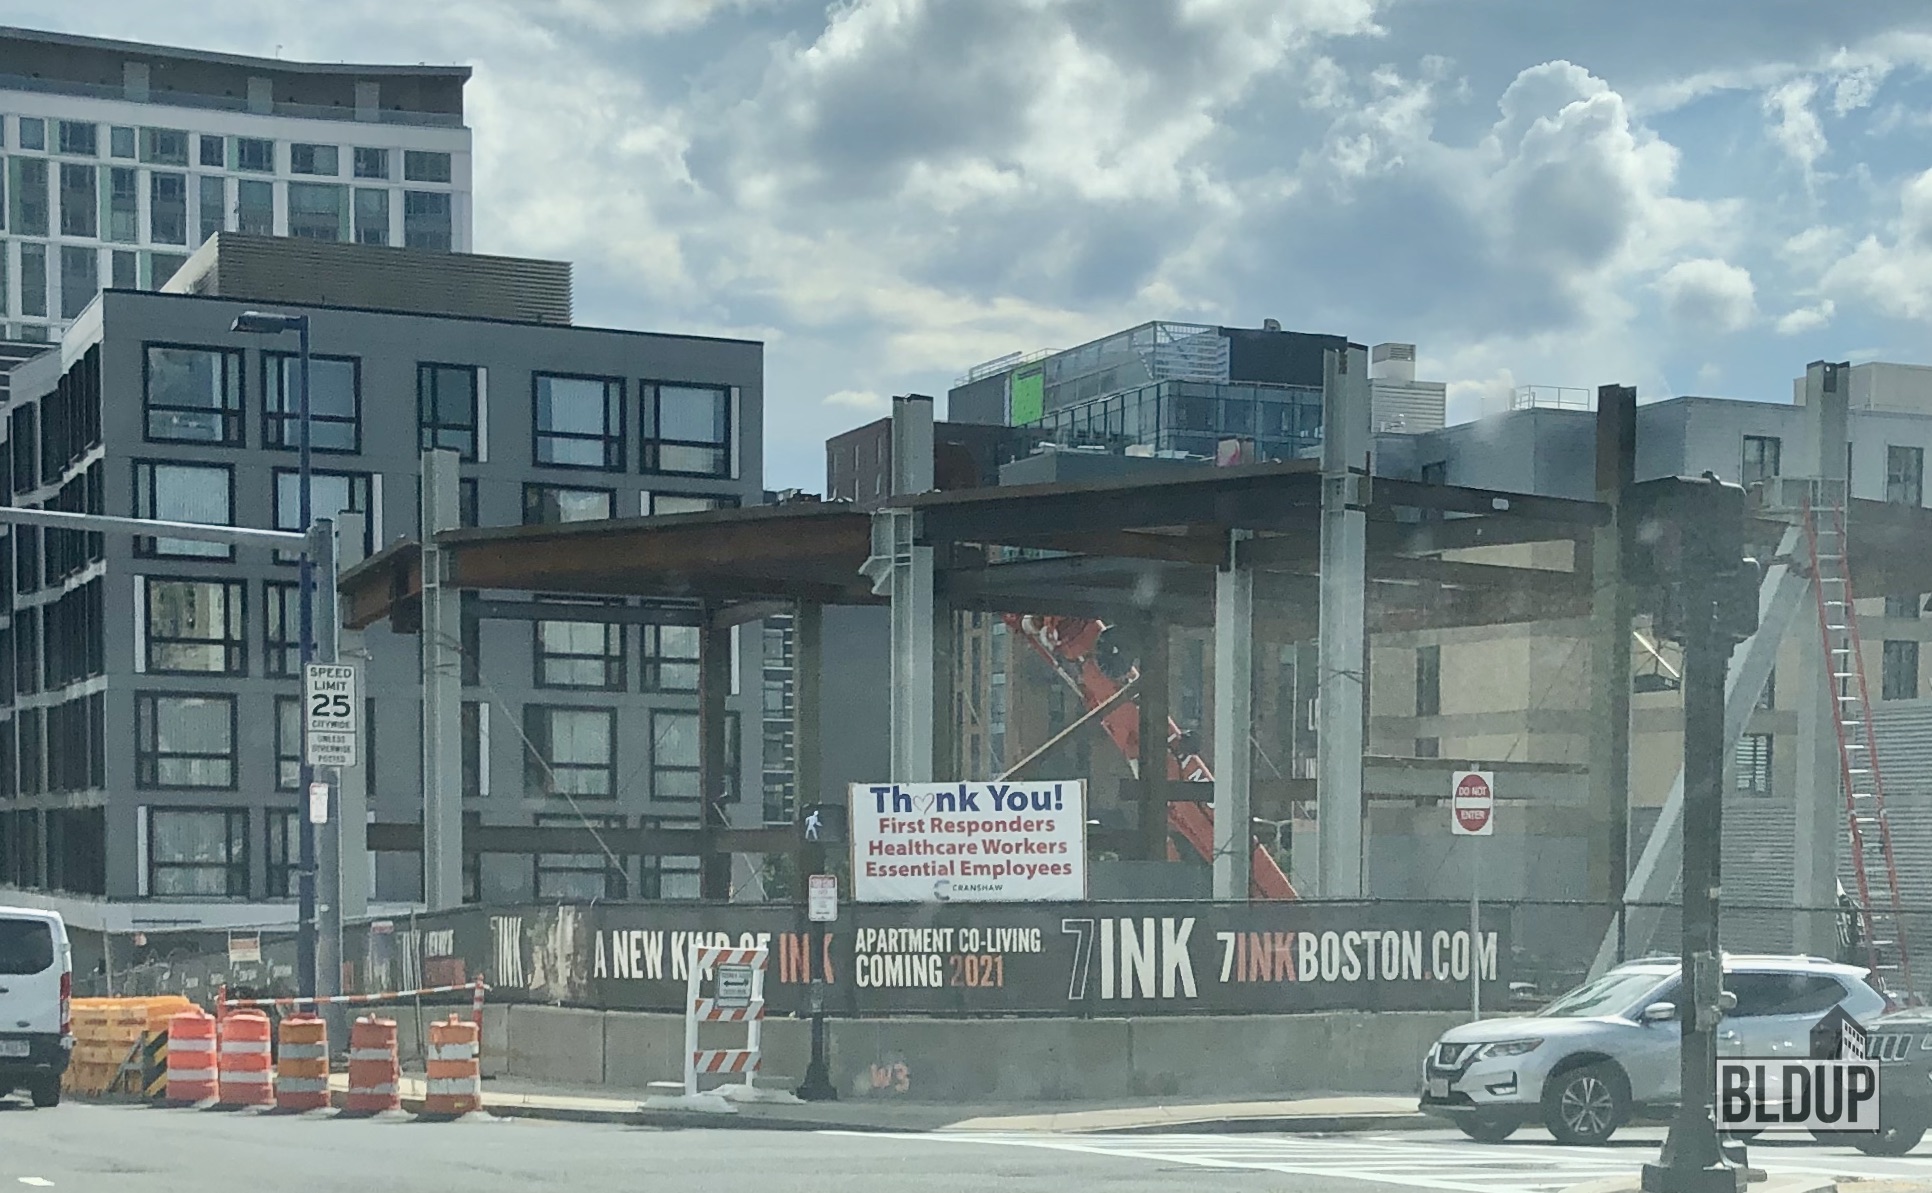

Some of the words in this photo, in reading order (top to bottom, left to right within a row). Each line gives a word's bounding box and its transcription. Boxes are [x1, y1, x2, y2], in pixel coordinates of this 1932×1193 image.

[310, 667, 352, 678] SPEED
[314, 681, 347, 691] LIMIT
[312, 694, 350, 717] 25
[870, 784, 981, 814] Thnk
[986, 784, 1063, 812] You!
[1459, 787, 1469, 796] DO
[1472, 786, 1487, 796] NOT
[1461, 810, 1485, 819] ENTER
[879, 817, 925, 834] First
[931, 816, 1055, 837] Responders
[869, 839, 978, 856] Healthcare
[981, 839, 1067, 855] Workers
[866, 860, 954, 877] Essential
[960, 860, 1072, 880] Employees
[855, 928, 954, 953] APARTMENT
[594, 930, 607, 978] A
[613, 930, 664, 980] NEW
[1061, 917, 1198, 1000] 7INK
[1216, 930, 1498, 983] 7INKBOSTON.COM
[856, 954, 943, 988] COMING
[950, 955, 1004, 988] 2021
